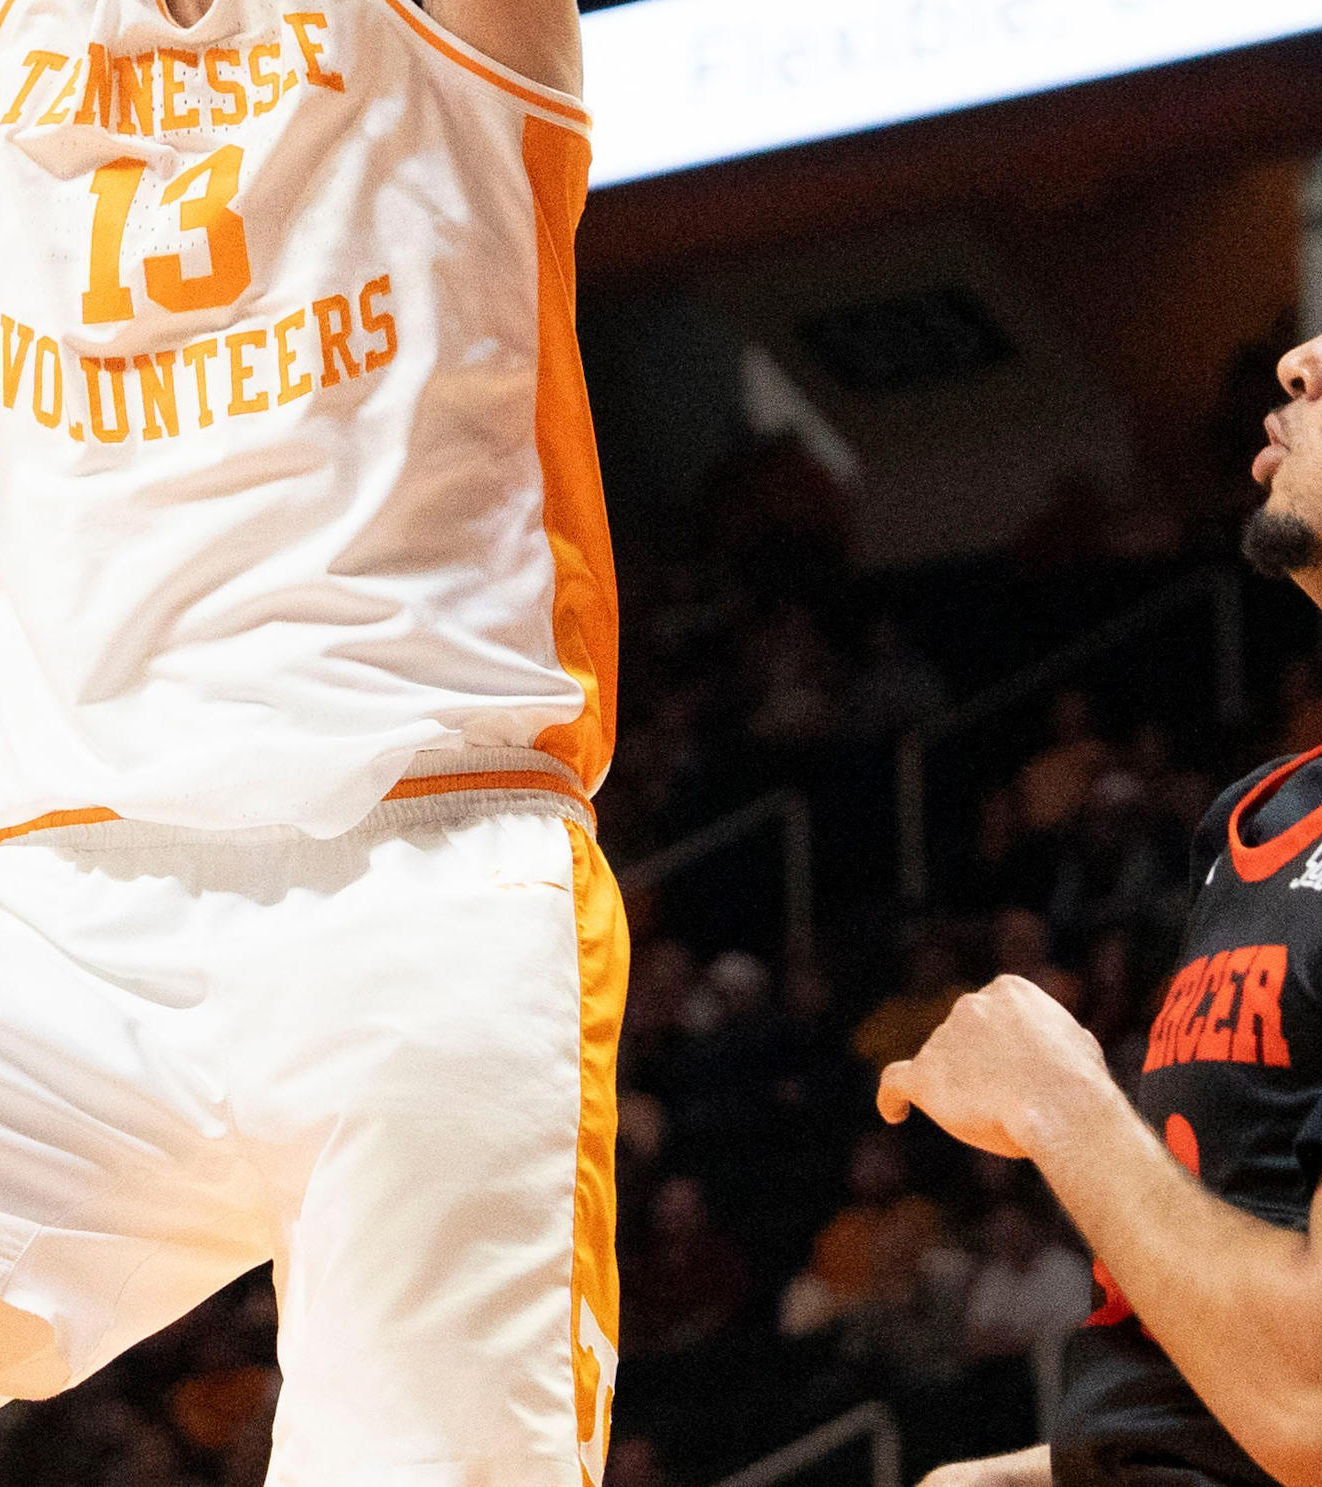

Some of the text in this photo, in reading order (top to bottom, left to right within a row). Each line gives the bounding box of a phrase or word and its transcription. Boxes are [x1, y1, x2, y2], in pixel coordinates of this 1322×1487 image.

[0, 12, 345, 137] TENNESSE
[82, 144, 251, 325] 13
[0, 273, 399, 443] VOUNTEERS
